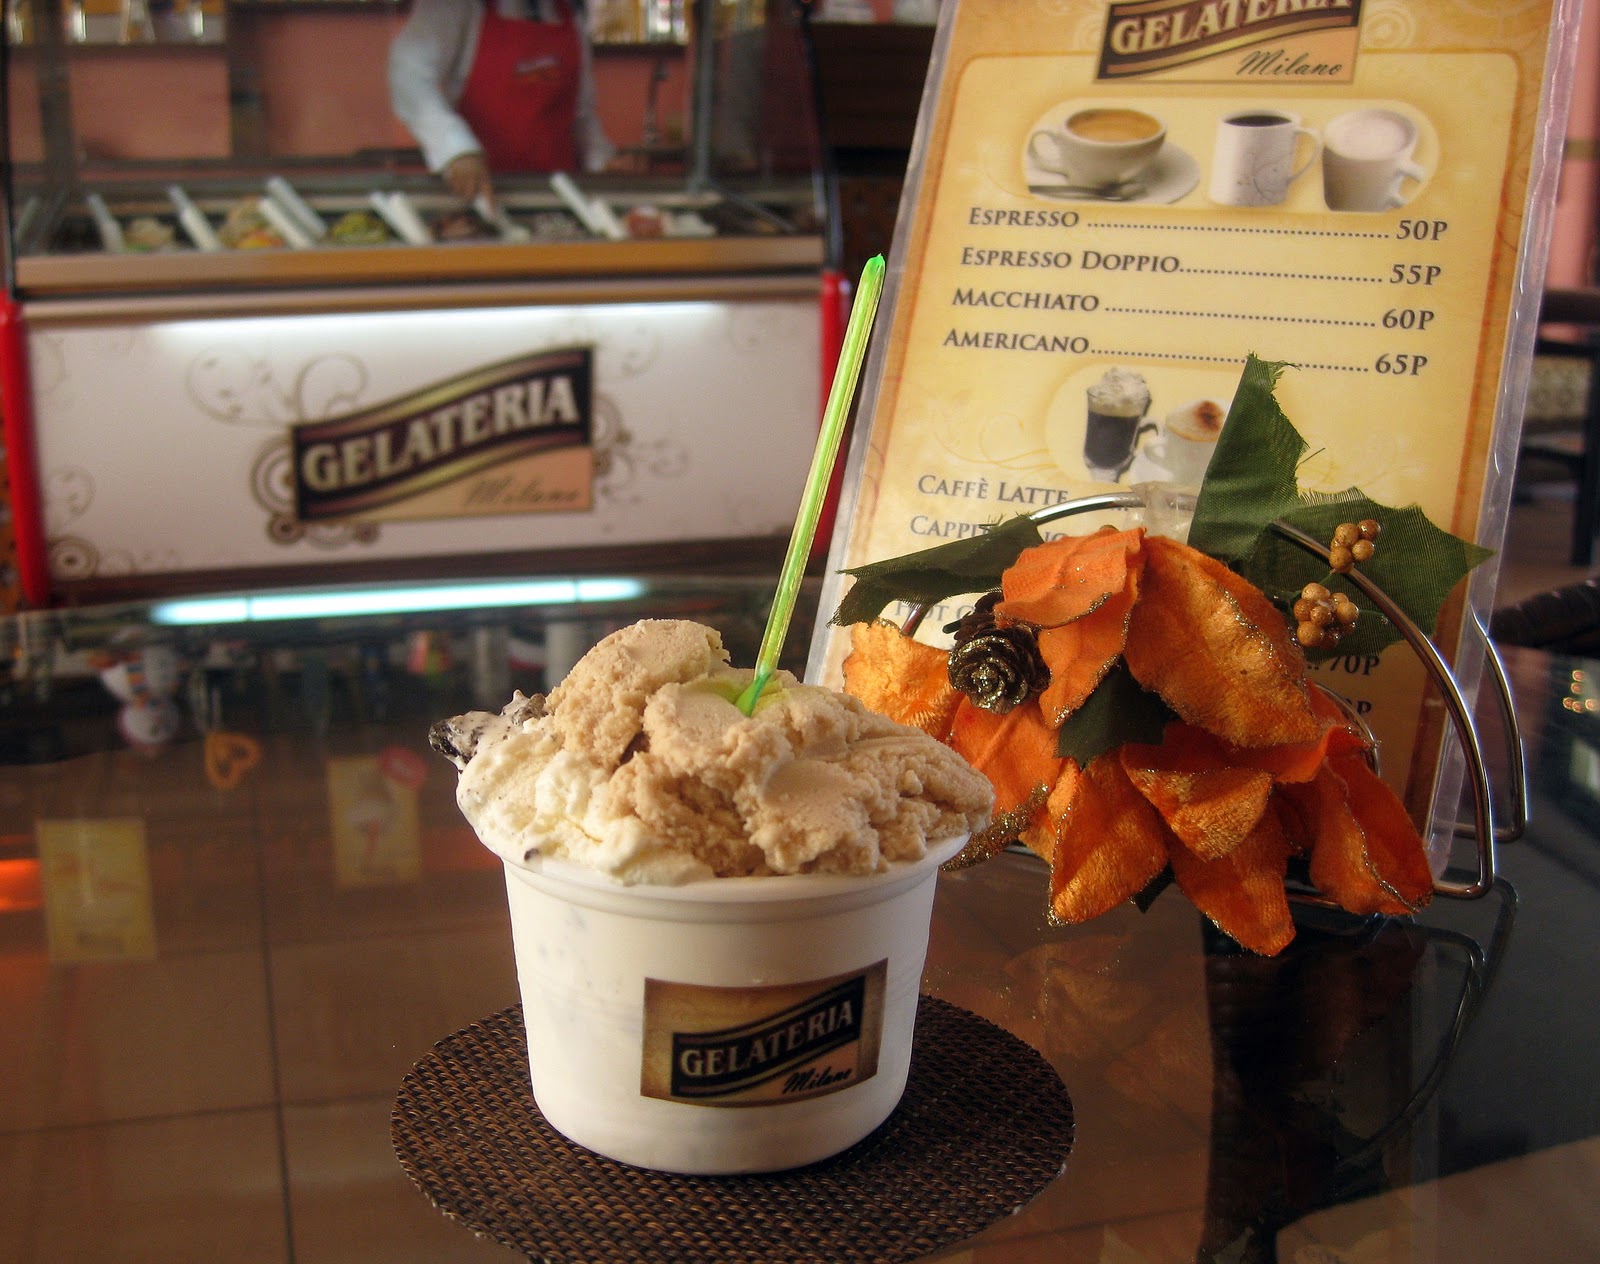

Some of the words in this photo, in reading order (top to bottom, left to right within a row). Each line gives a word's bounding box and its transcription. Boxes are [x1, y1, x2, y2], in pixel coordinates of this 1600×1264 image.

[1236, 49, 1343, 76] Milano
[968, 206, 1080, 228] ESPRESSO
[1396, 219, 1448, 241] 50P
[961, 247, 1072, 269] ESPRESSO
[1080, 250, 1180, 273] DOPPIO
[1389, 263, 1442, 286] 55P
[952, 287, 1100, 312] MACCHIATO
[1382, 308, 1435, 331] 60P
[943, 328, 1090, 354] AMERICANO
[1375, 353, 1428, 376] 65P
[302, 375, 580, 493] GELATERIA
[917, 474, 989, 500] CAFFÈ
[996, 481, 1069, 506] LATTE
[680, 1000, 855, 1077] GELATERIA
[781, 1067, 853, 1095] Milano
